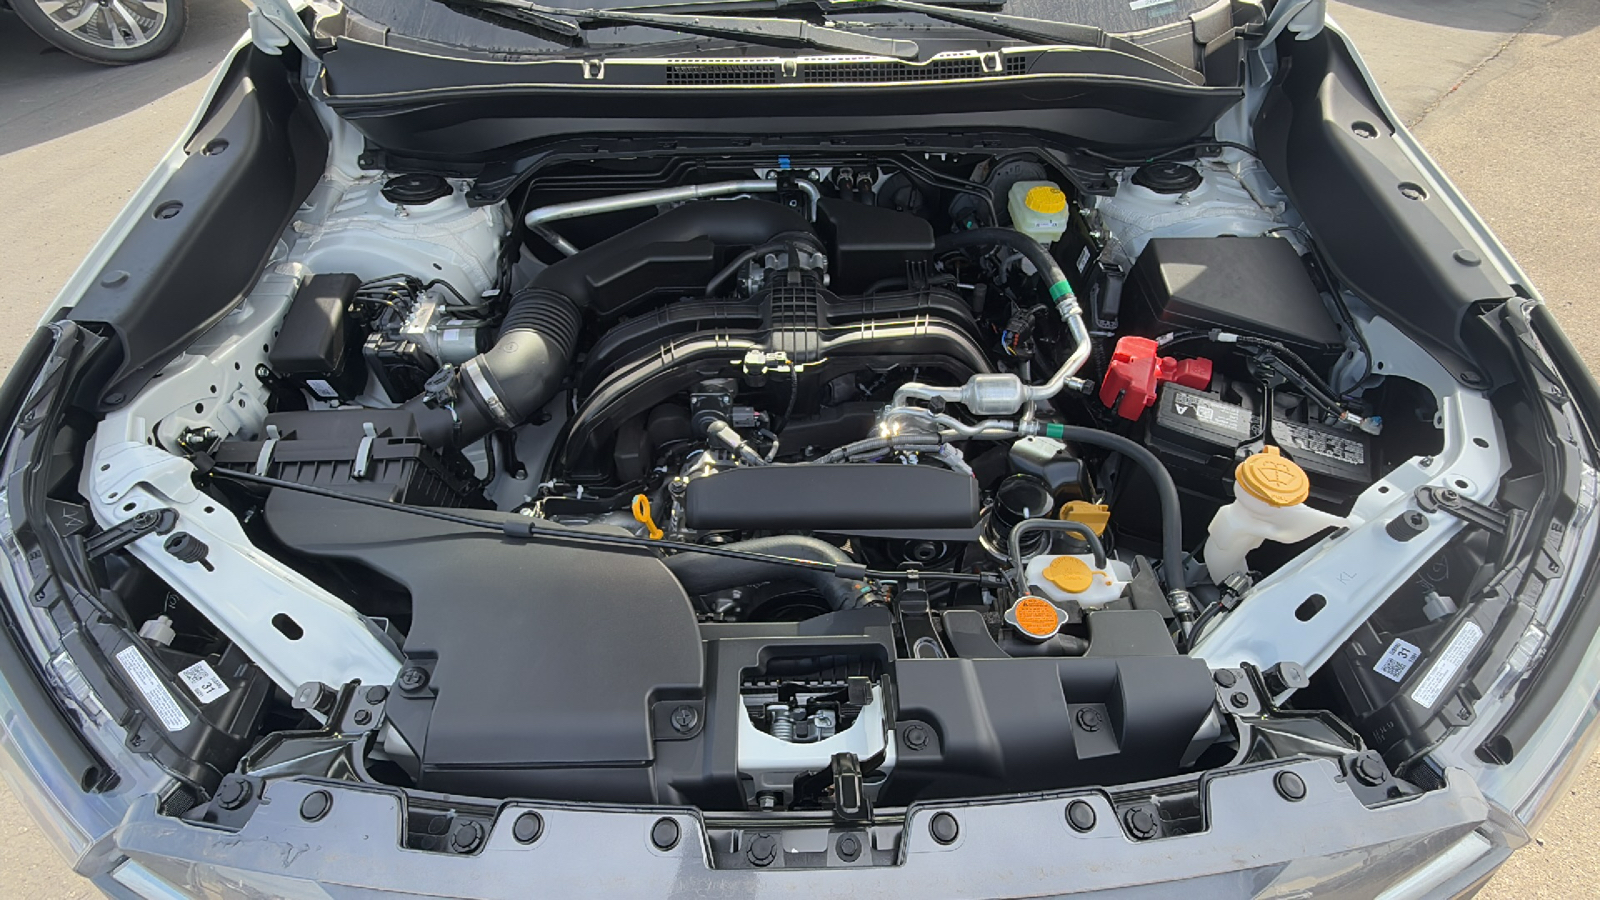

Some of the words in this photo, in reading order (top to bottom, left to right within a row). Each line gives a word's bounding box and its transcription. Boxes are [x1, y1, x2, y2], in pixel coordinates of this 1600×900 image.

[1335, 571, 1358, 586] KL
[1397, 647, 1411, 659] 31
[201, 682, 216, 694] 31
